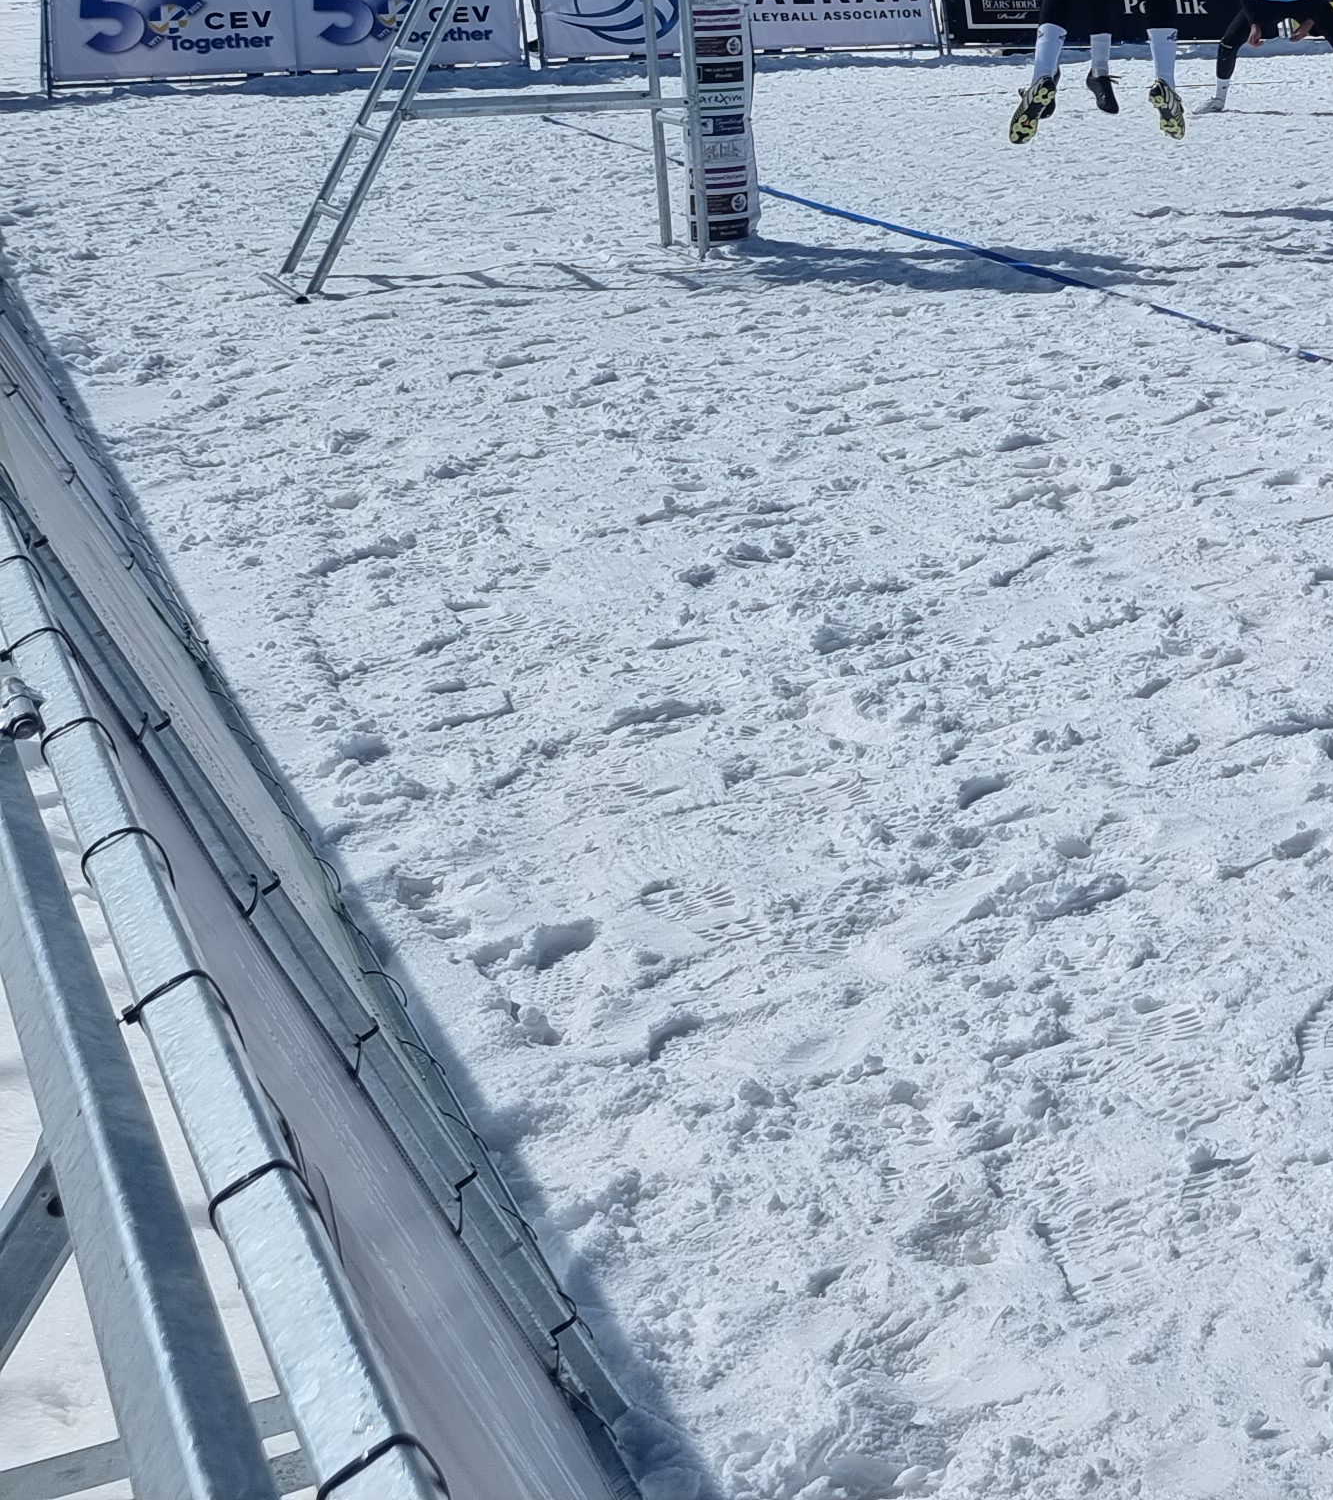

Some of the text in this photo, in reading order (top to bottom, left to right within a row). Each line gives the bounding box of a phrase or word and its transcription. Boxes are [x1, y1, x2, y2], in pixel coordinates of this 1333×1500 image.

[982, 0, 1010, 9] BEARS
[204, 11, 271, 30] CEV
[428, 6, 490, 23] CEV
[751, 12, 818, 22] LEYBALL
[823, 9, 922, 21] ASSOCIATION
[167, 33, 274, 54] Together
